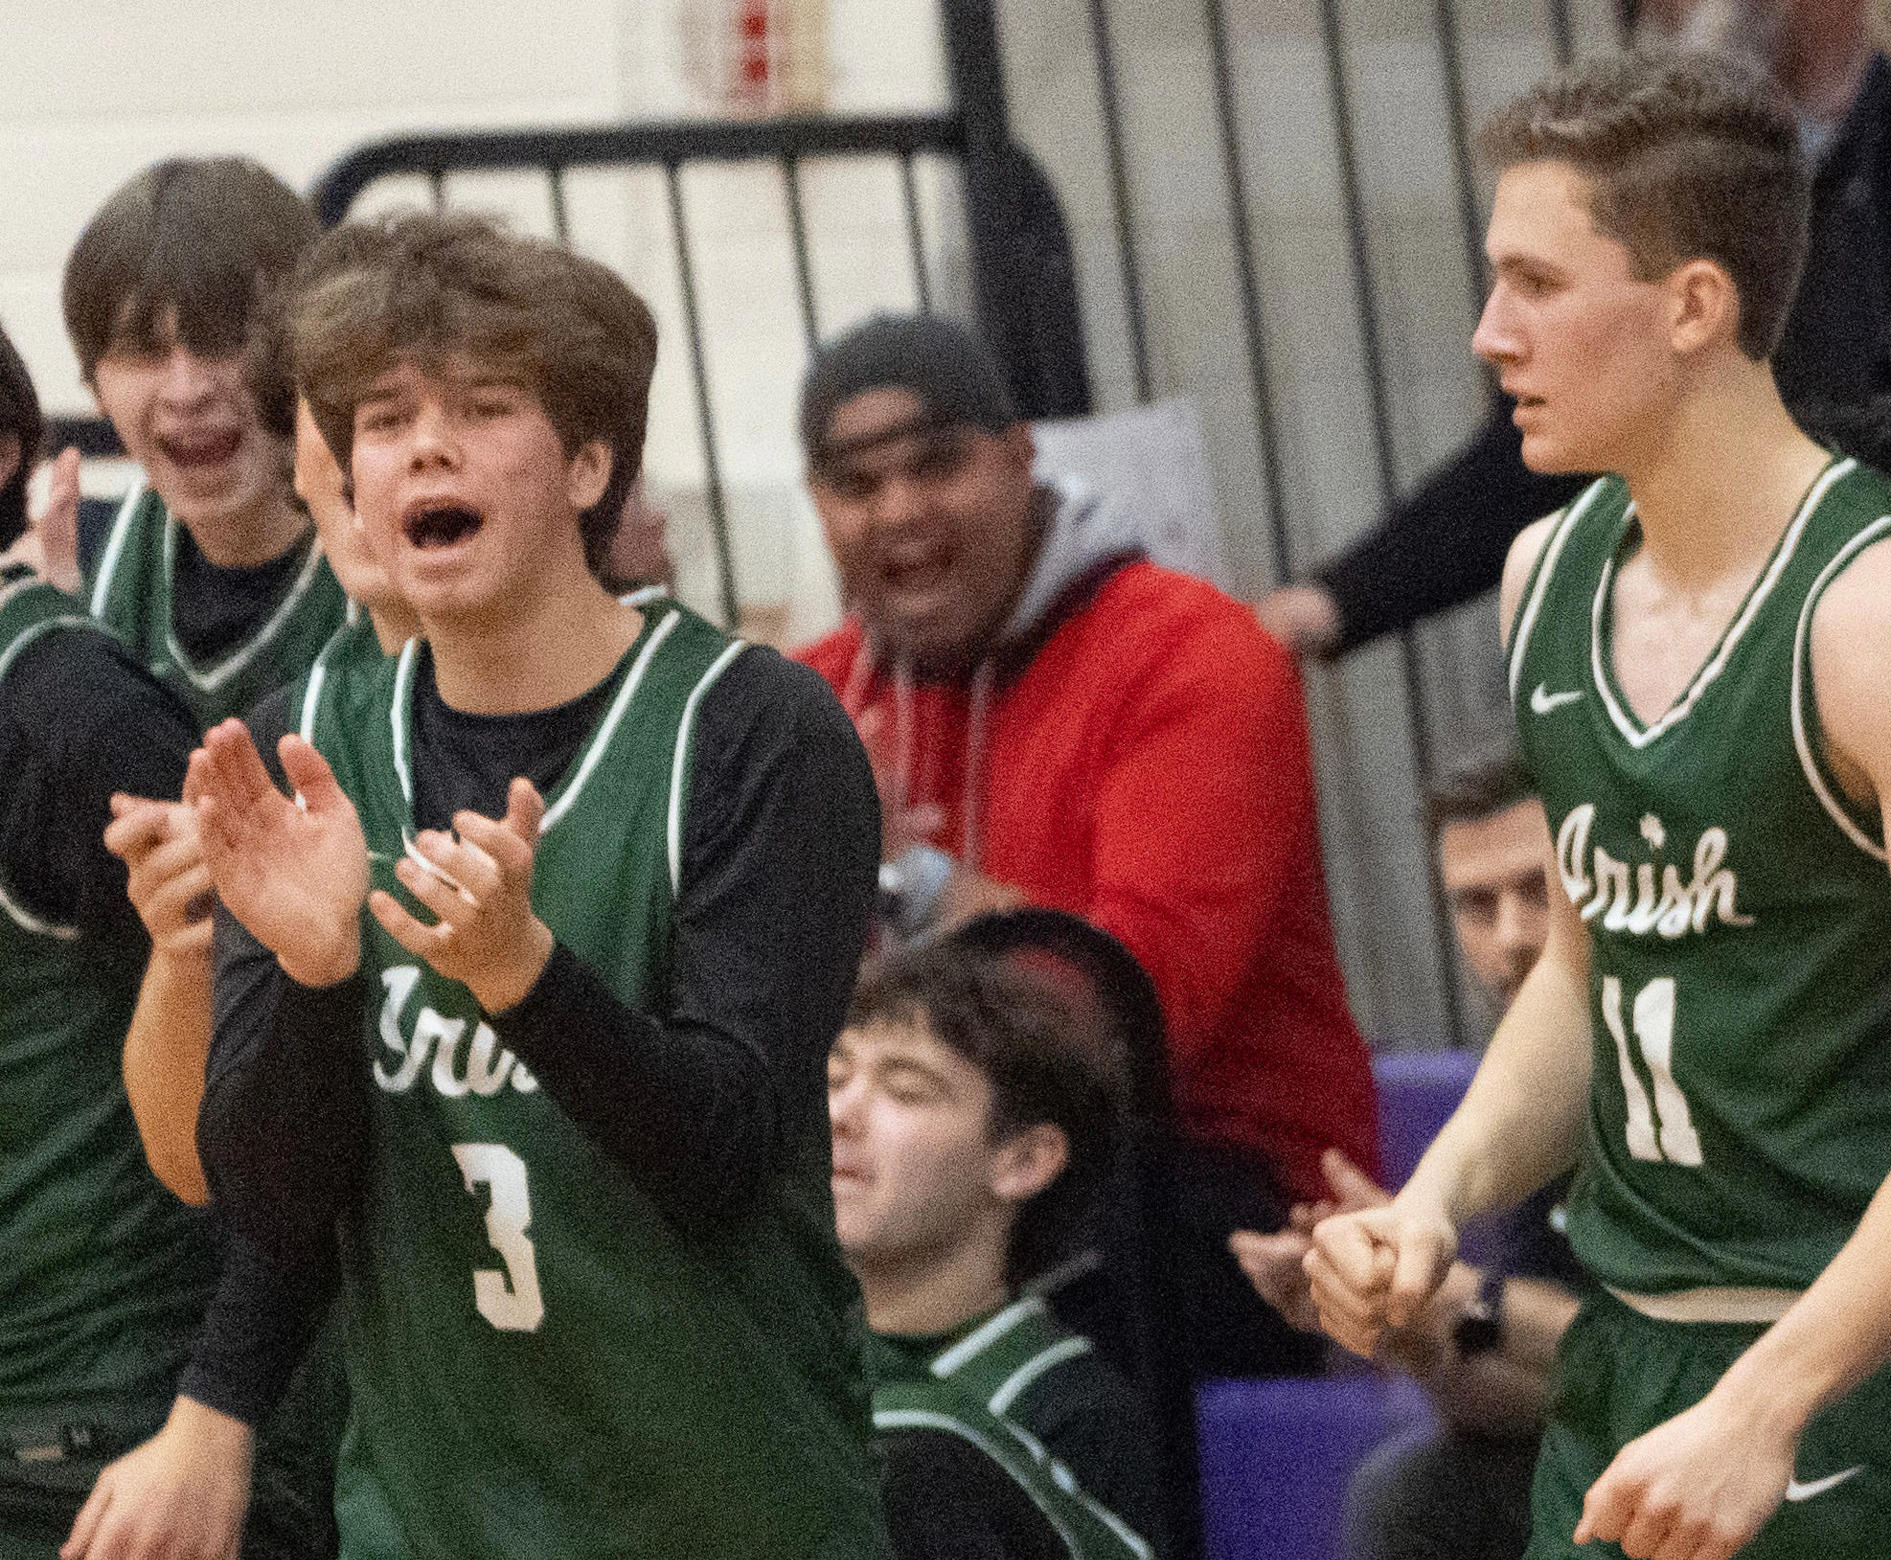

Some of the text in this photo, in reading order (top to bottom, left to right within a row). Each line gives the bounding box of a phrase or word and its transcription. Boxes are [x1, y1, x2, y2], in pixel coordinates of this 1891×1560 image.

[1557, 803, 1756, 938] Irish
[373, 965, 539, 1096] Iri
[1602, 976, 1703, 1167] 11
[452, 1143, 545, 1331] 3
